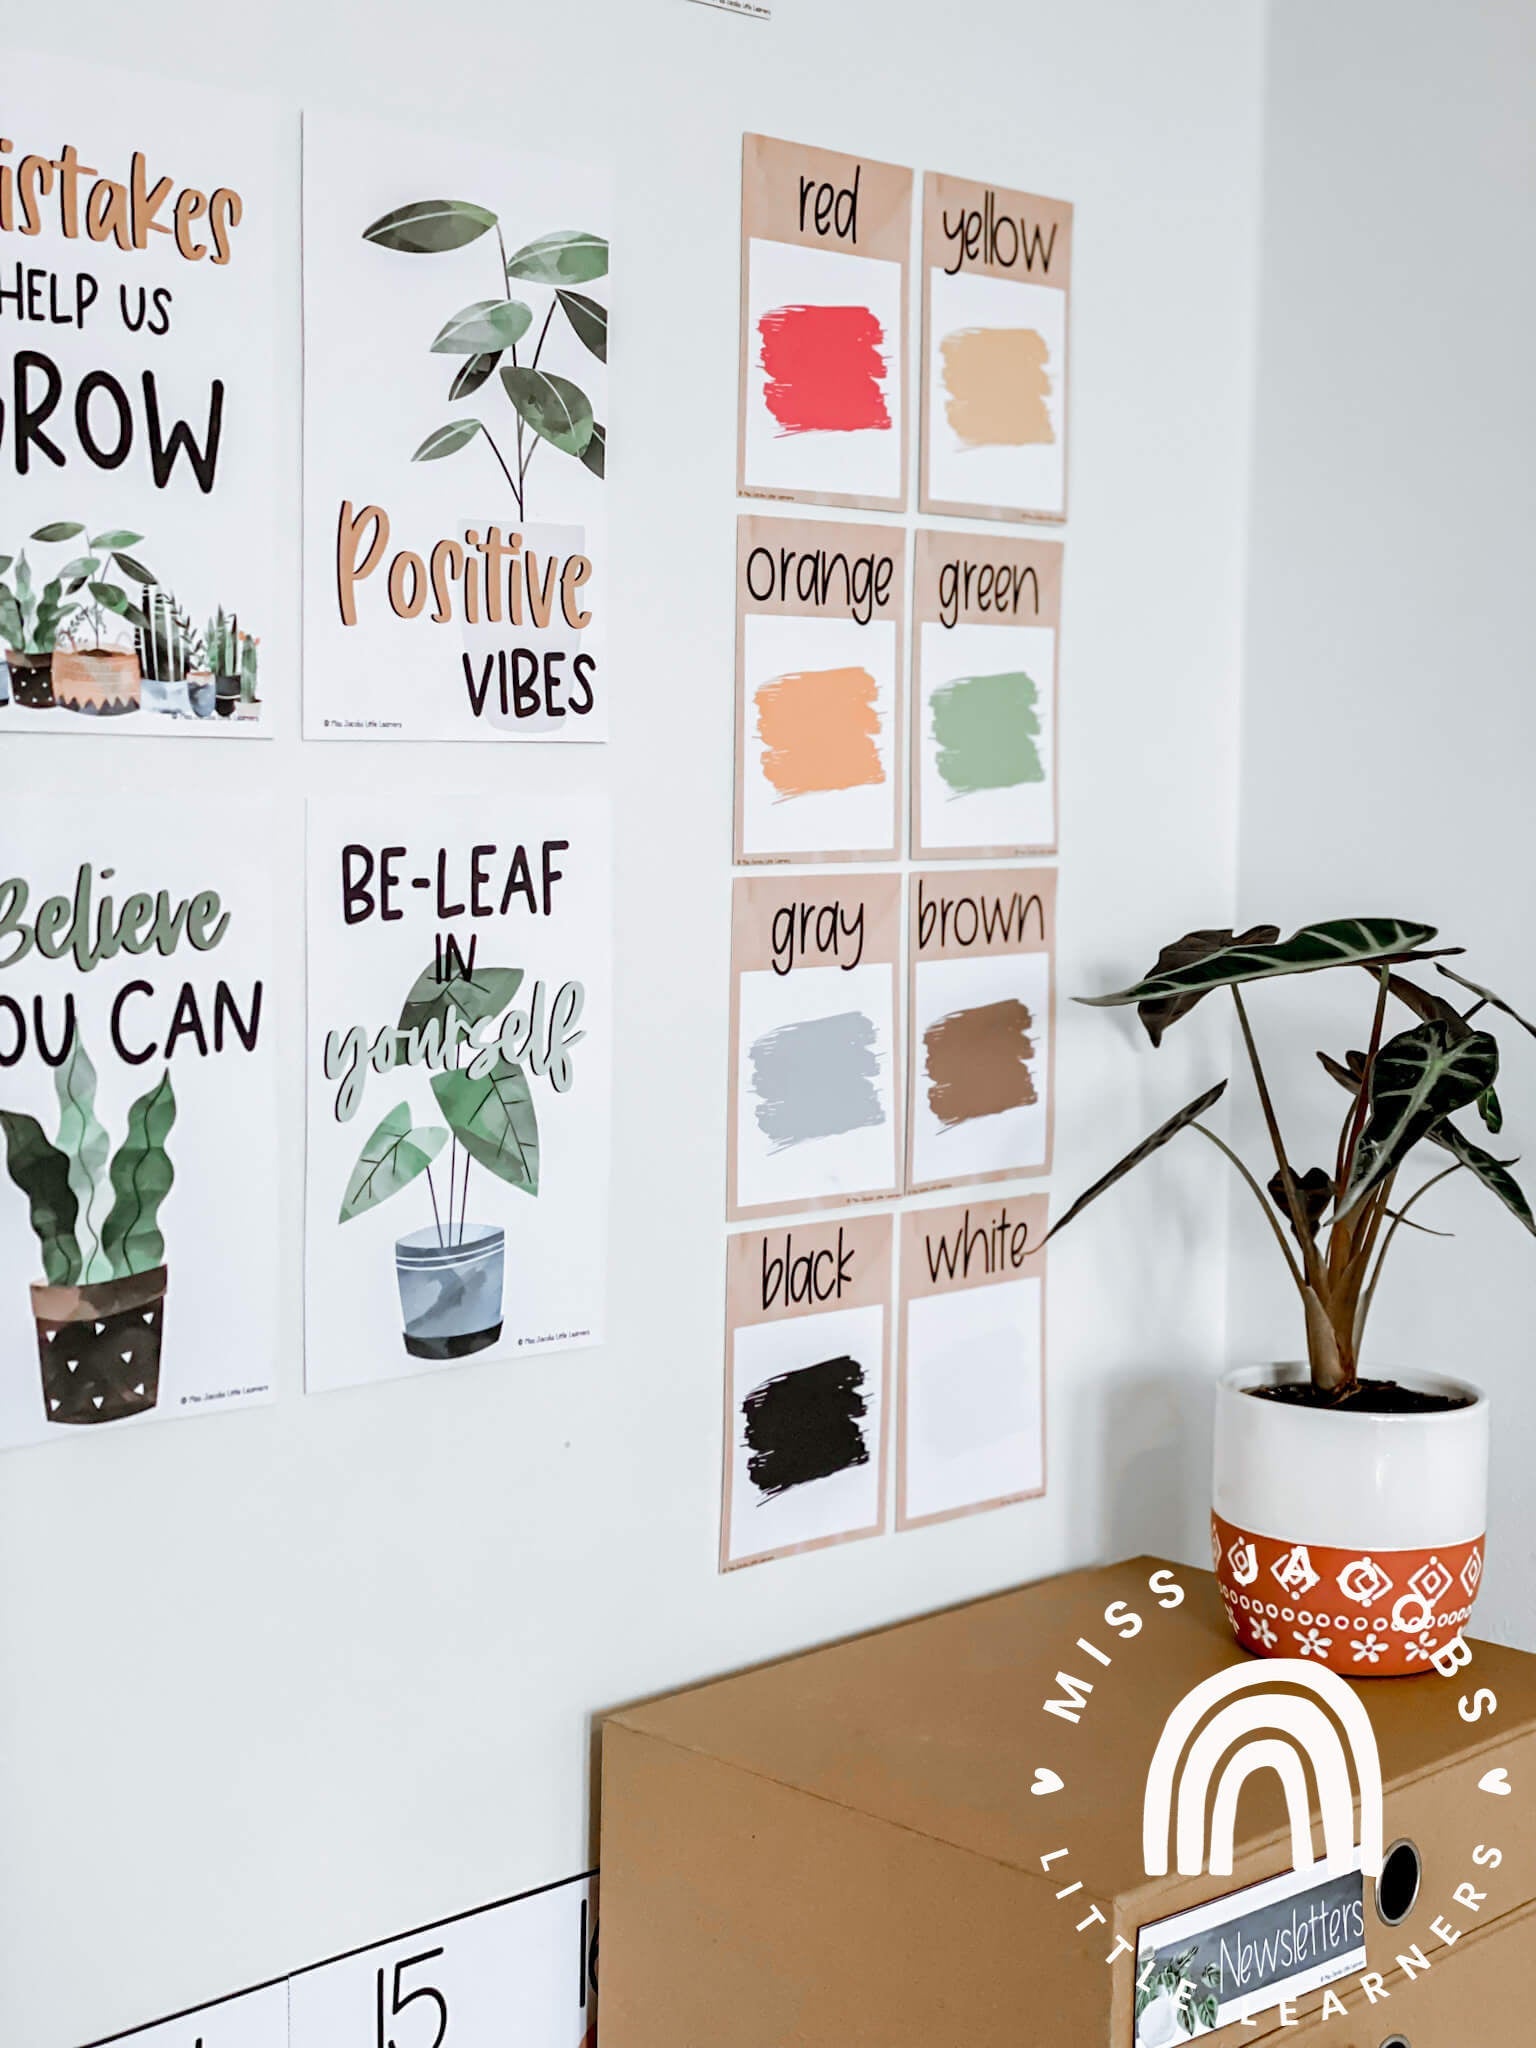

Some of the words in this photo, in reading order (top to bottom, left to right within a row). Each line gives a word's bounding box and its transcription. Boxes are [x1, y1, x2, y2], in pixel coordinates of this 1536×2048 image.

[800, 165, 860, 244] red
[944, 191, 1057, 275] yellow
[0, 261, 98, 328] HELP
[120, 285, 172, 335] US
[0, 350, 224, 494] ROW
[337, 500, 592, 628] Positive
[746, 547, 893, 625] orange
[939, 560, 1039, 629] green
[462, 648, 596, 718] VIBES
[342, 840, 569, 925] BE-LEAF
[918, 879, 1044, 949] brown
[435, 933, 477, 985] IN
[772, 902, 864, 975] gray
[111, 979, 263, 1065] CAN
[324, 980, 587, 1122] yourself
[762, 1226, 855, 1311] black
[926, 1207, 1028, 1283] white
[1220, 1899, 1365, 1994] Newsletters
